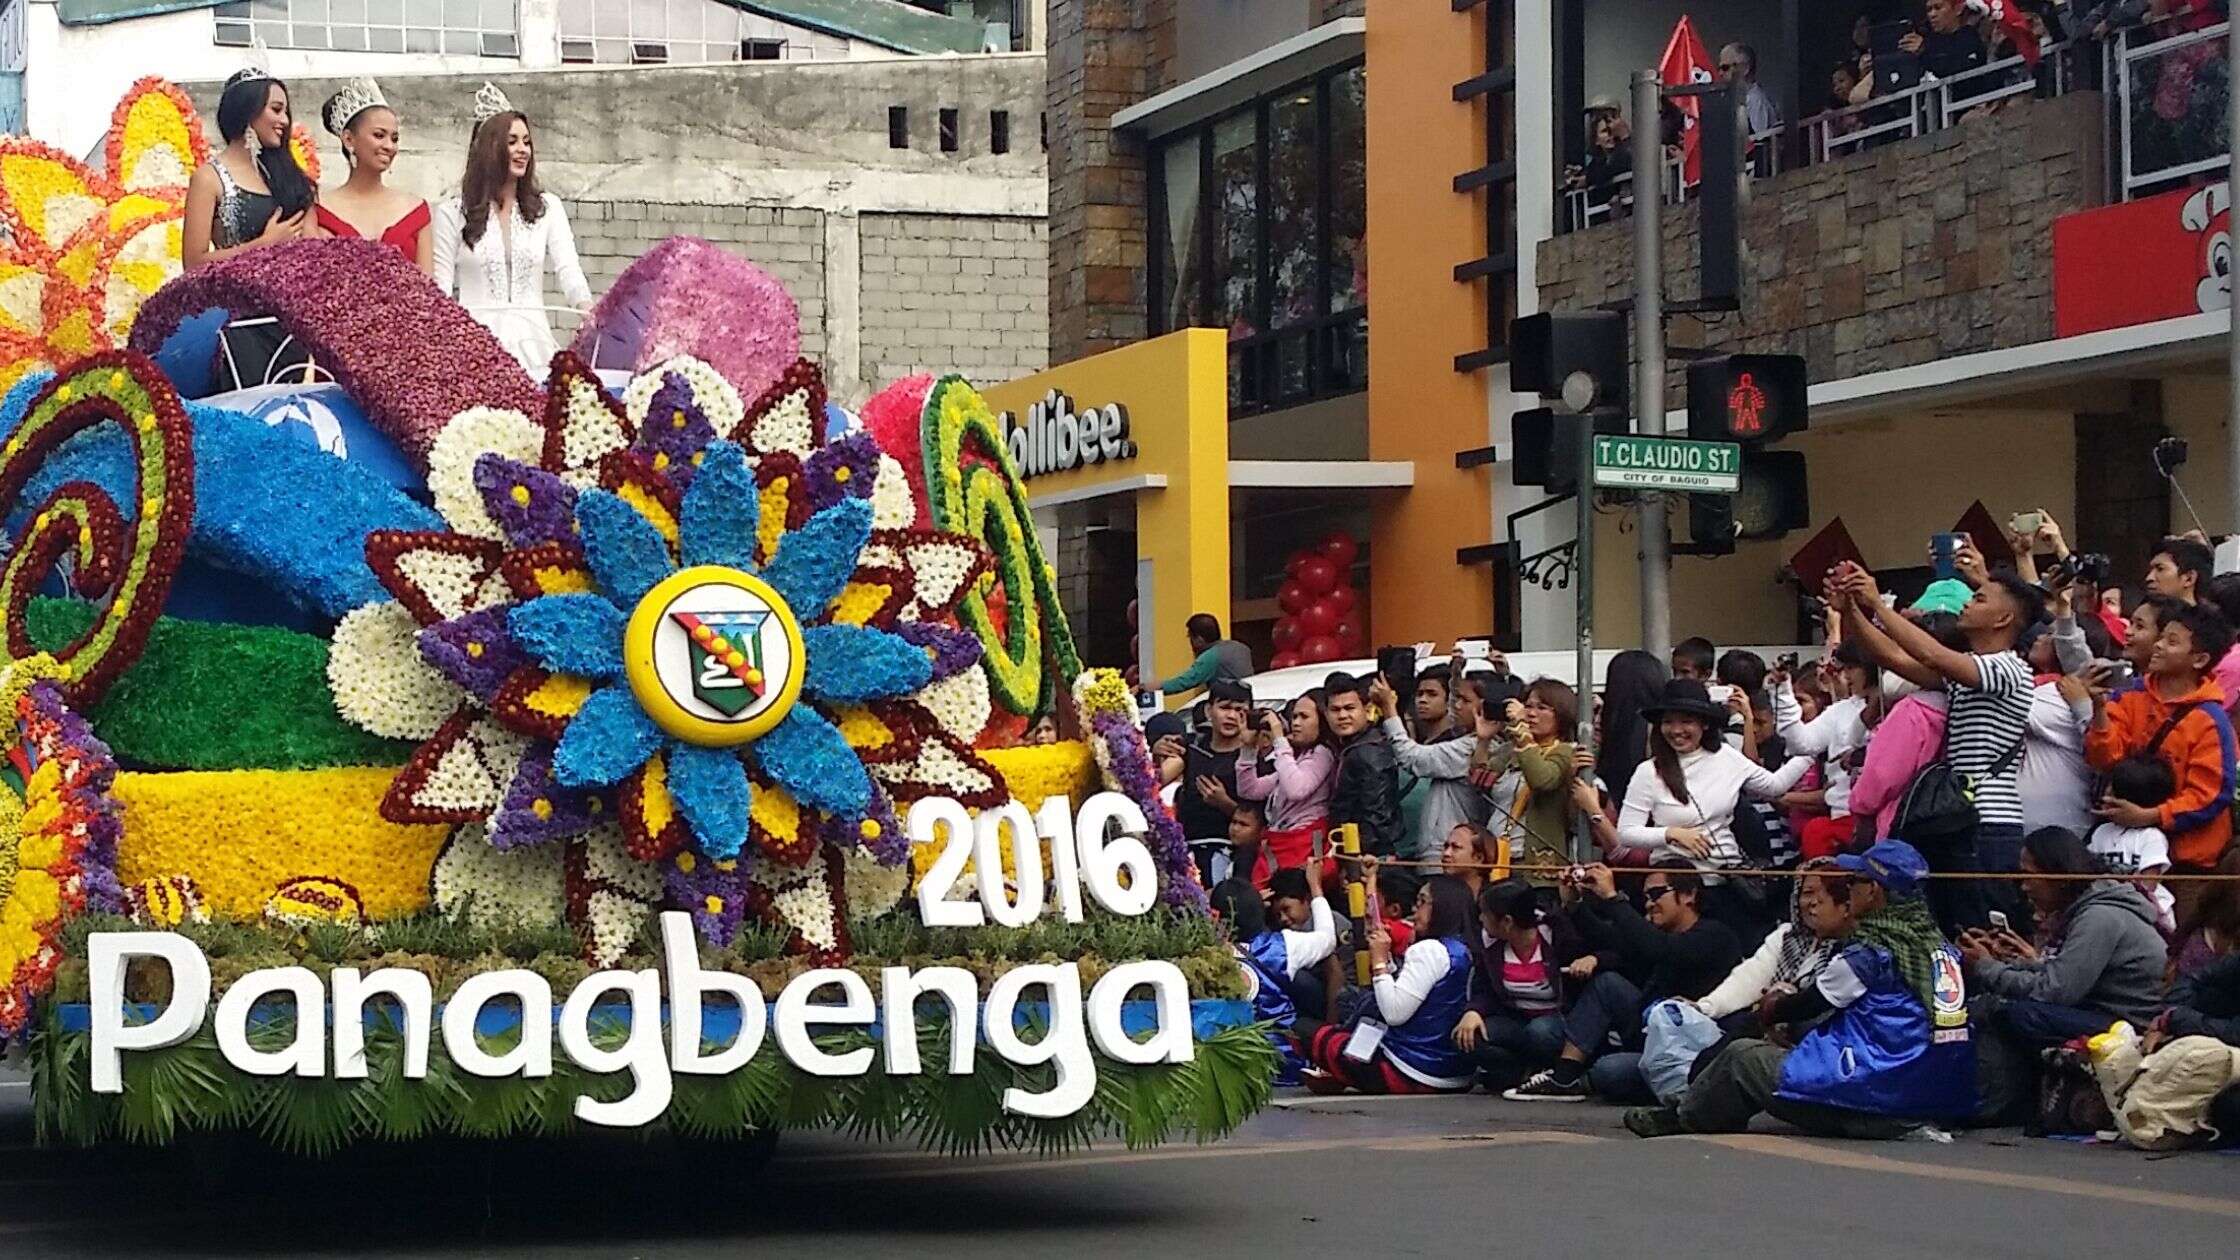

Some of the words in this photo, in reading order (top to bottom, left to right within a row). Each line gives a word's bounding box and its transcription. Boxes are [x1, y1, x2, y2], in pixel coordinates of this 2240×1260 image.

[1616, 442, 1702, 471] CLAUDIO
[1707, 447, 1734, 472] ST.
[1623, 472, 1648, 483] CITY
[1651, 474, 1666, 484] OF
[1669, 475, 1710, 486] BAGUIO
[907, 791, 1158, 928] 2016
[88, 910, 1195, 1128] Panagbenga
